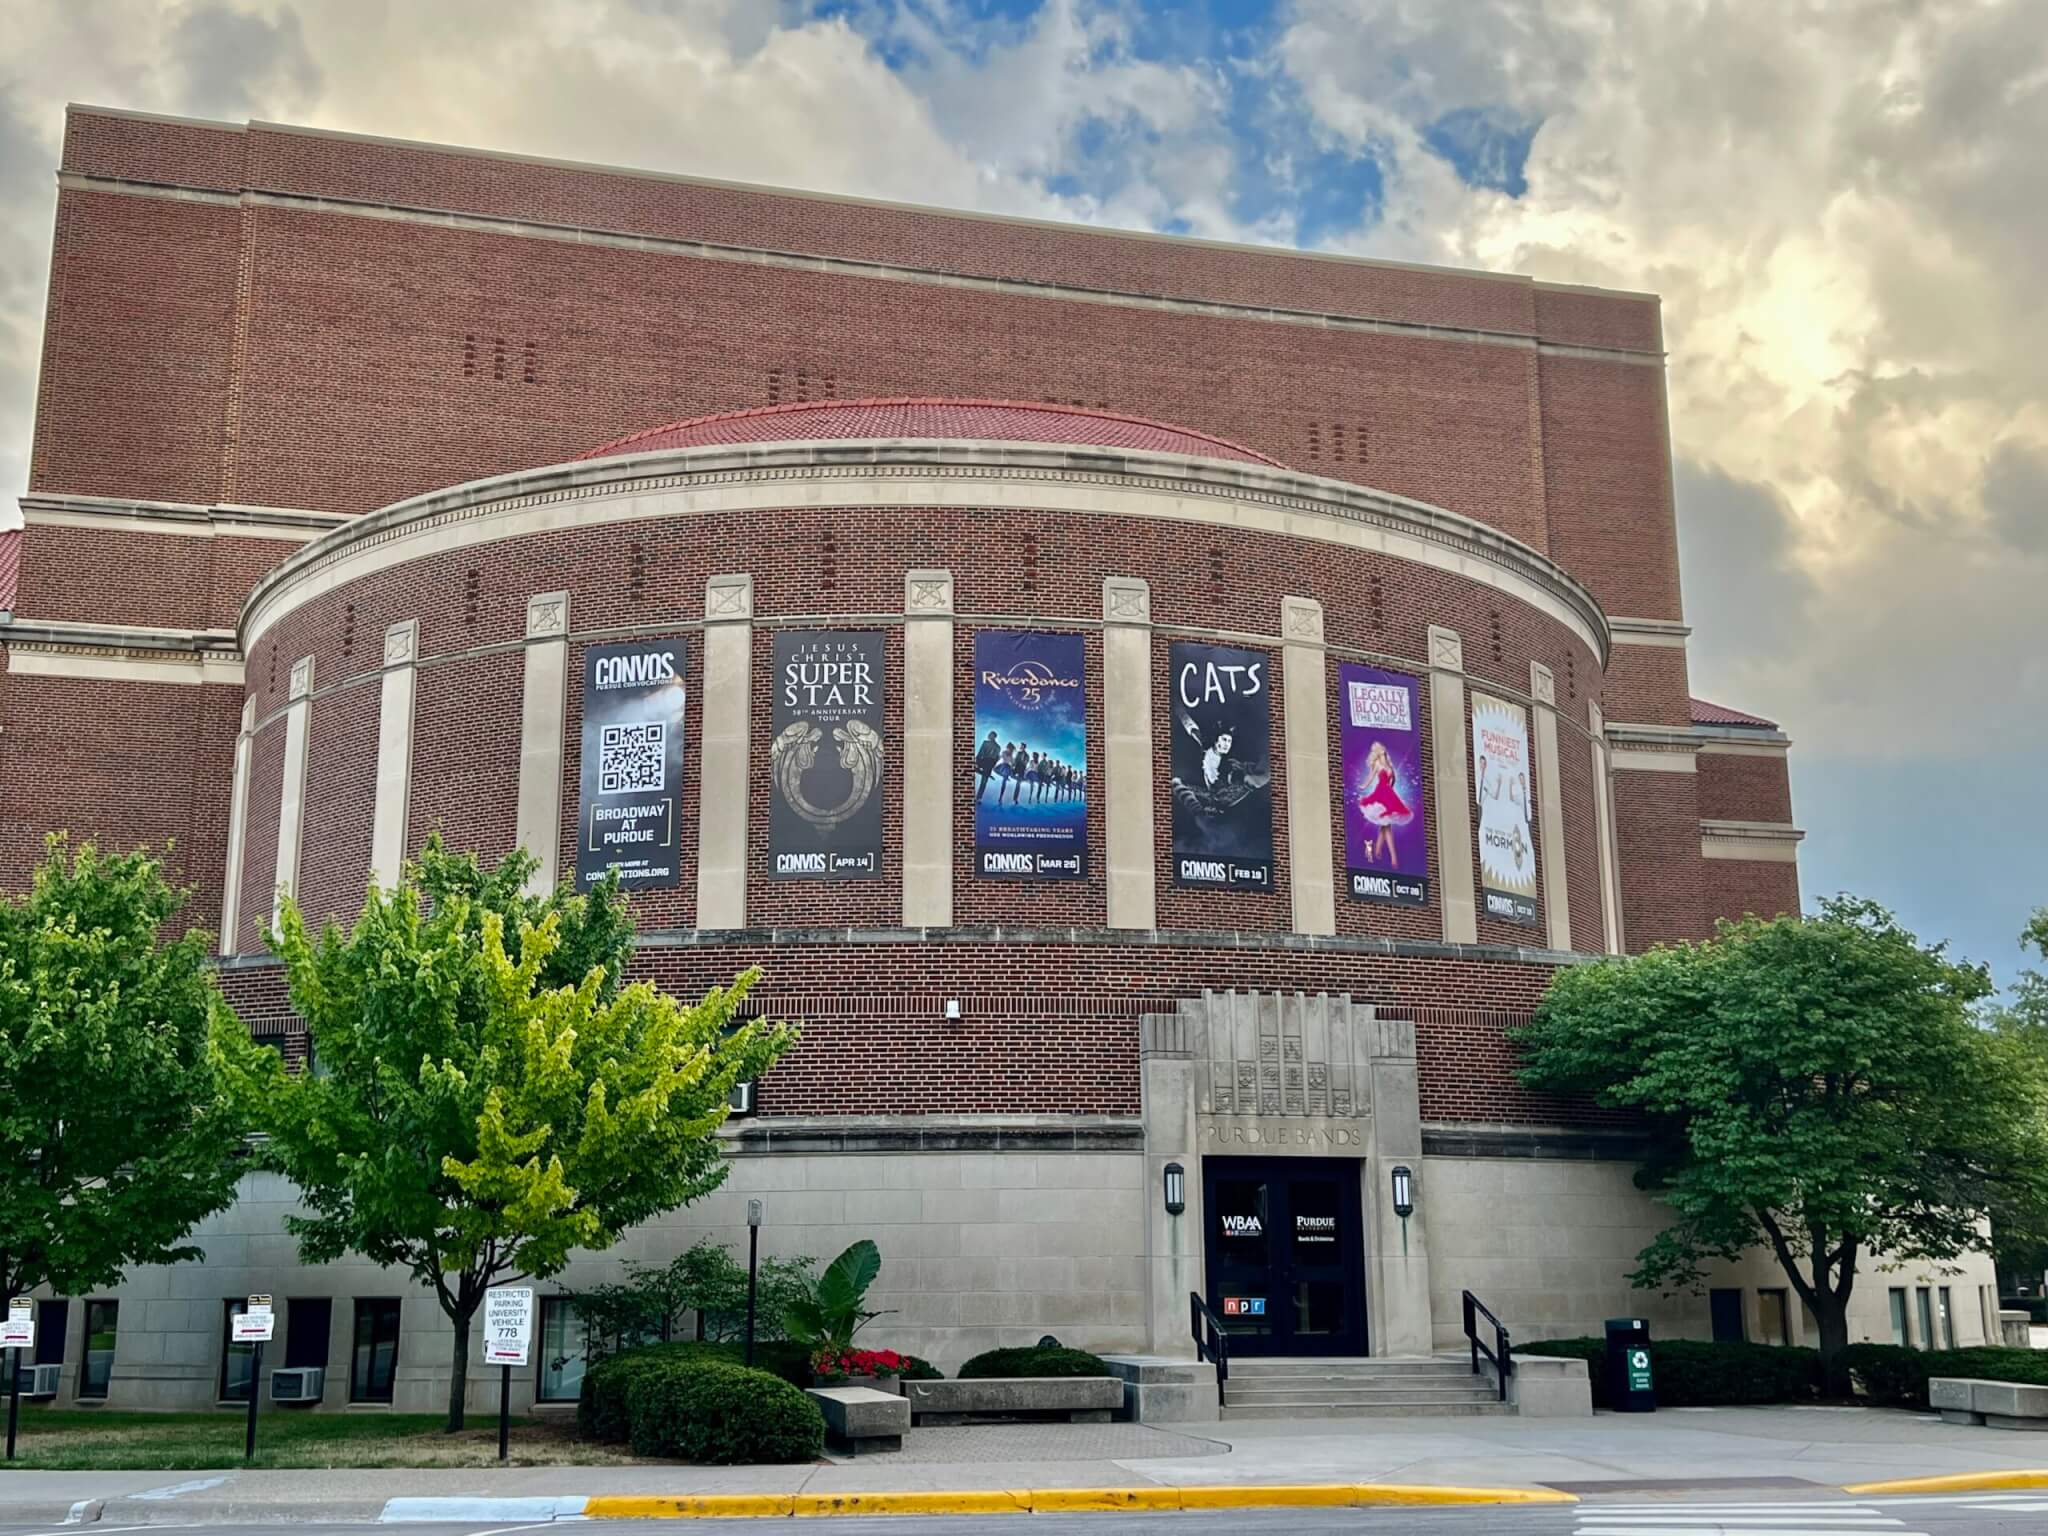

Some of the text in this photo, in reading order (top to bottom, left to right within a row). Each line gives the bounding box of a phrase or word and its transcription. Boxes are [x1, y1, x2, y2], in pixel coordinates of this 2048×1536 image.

[801, 643, 858, 654] JESUS
[791, 653, 866, 663] CHRIST
[595, 652, 675, 686] CONVOS
[785, 662, 874, 685] SUPER
[981, 670, 1079, 690] Riverdance
[1180, 662, 1261, 708] CATS
[784, 684, 875, 707] STAR
[1022, 687, 1041, 704] 25
[1353, 687, 1405, 704] LEGALLY
[1355, 700, 1407, 717] BLONDE
[1481, 729, 1521, 750] FUNNIEST
[596, 804, 665, 821] BROADWAY
[621, 819, 637, 831] AT
[603, 829, 654, 845] PURDUE
[1485, 832, 1528, 855] MORMN
[777, 853, 868, 870] CONVOS APR 14
[984, 853, 1033, 870] CONVOS
[1040, 859, 1062, 868] MAR
[1181, 860, 1226, 879] CONVOS
[1354, 875, 1391, 895] CONVOS
[1208, 1126, 1361, 1147] PURDUE BANDS
[1222, 1215, 1262, 1231] WBAA
[1297, 1215, 1336, 1226] PURDUE
[488, 1290, 530, 1298] RESTRICTED
[494, 1299, 524, 1308] PARKING
[1228, 1300, 1261, 1313] npr
[488, 1309, 528, 1318] UNIVERSITY
[491, 1318, 526, 1327] VEHICLE
[498, 1327, 518, 1338] 778
